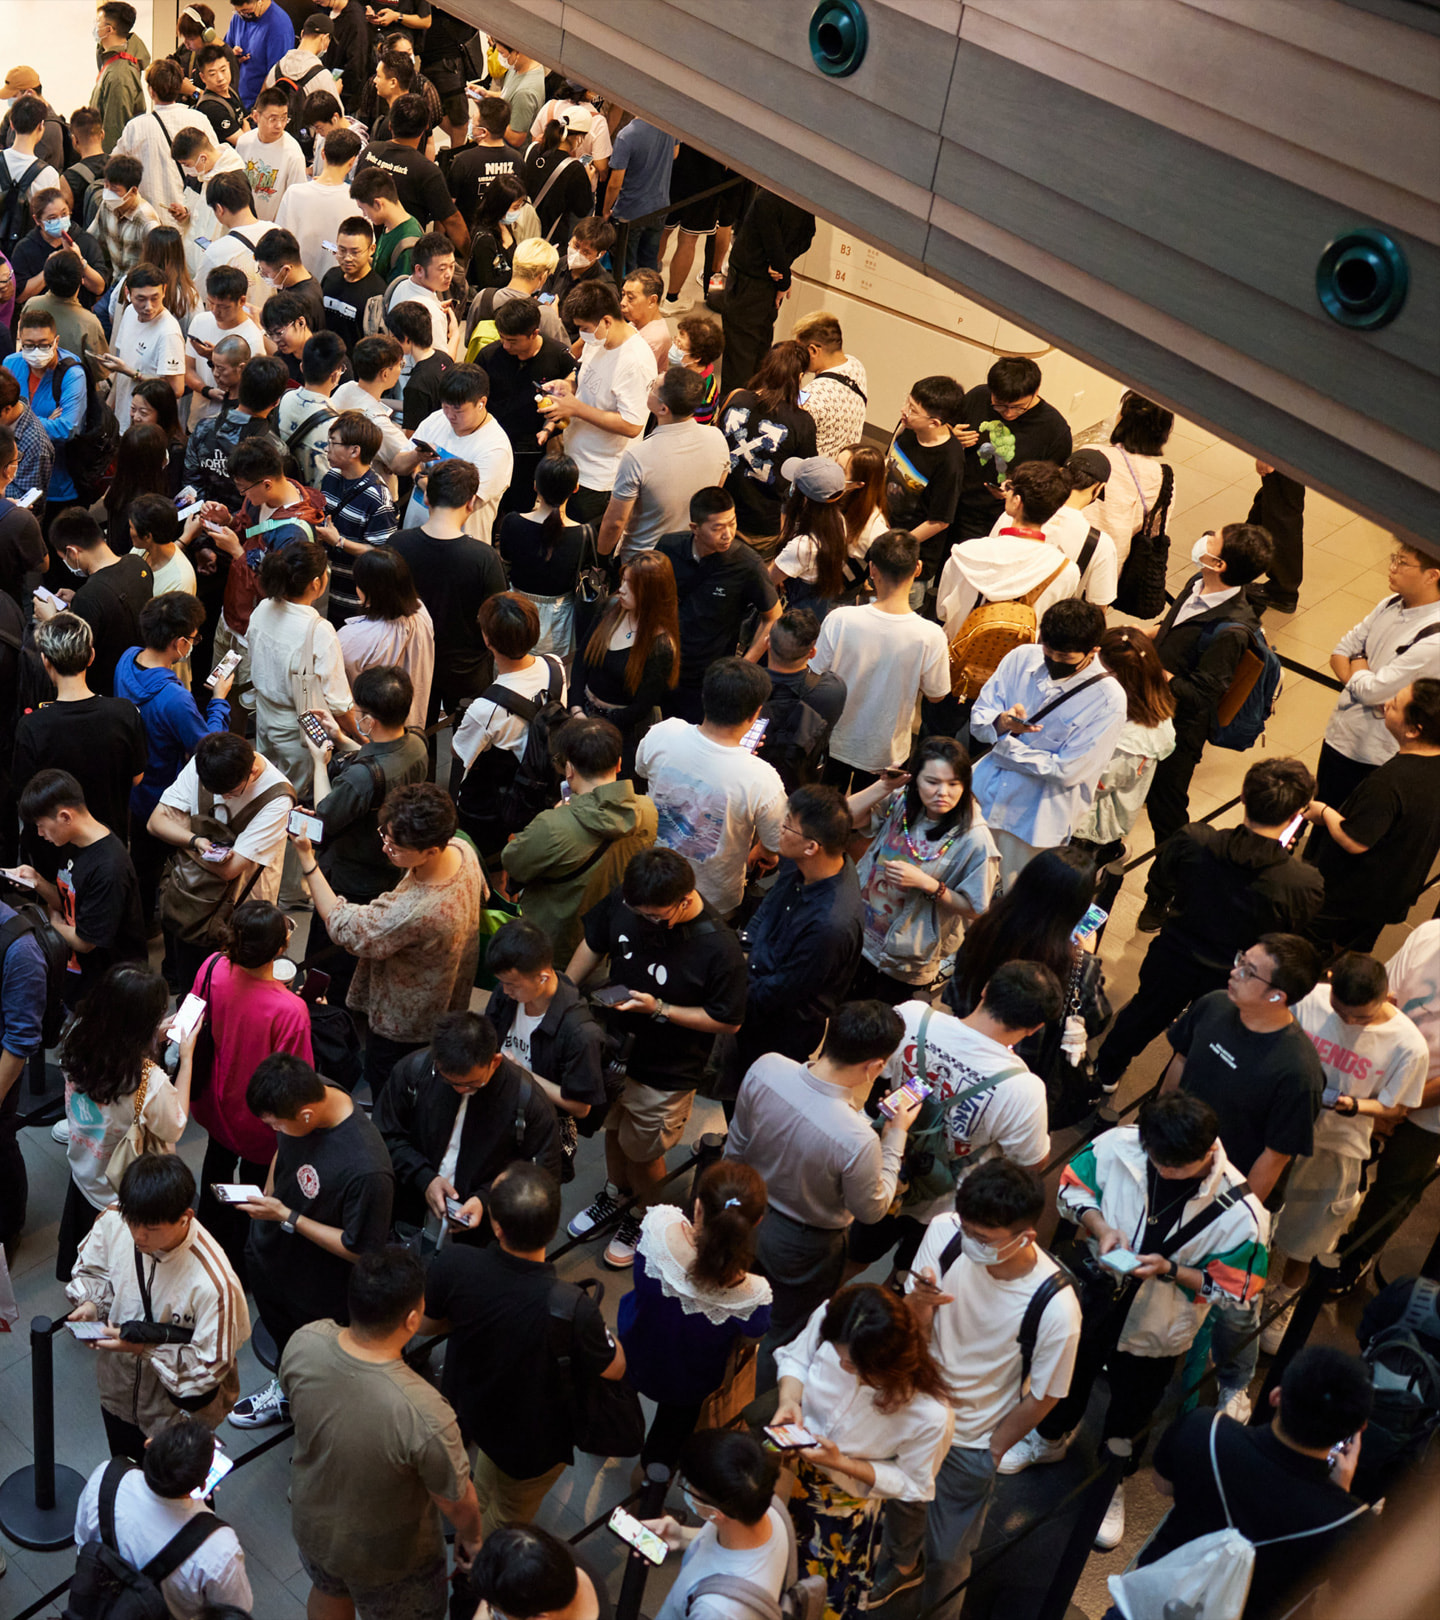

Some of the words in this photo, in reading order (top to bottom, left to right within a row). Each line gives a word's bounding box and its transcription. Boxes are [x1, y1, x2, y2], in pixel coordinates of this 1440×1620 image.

[840, 243, 852, 256] B3
[835, 269, 846, 282] B4
[957, 316, 964, 325] P
[200, 458, 227, 469] NORT
